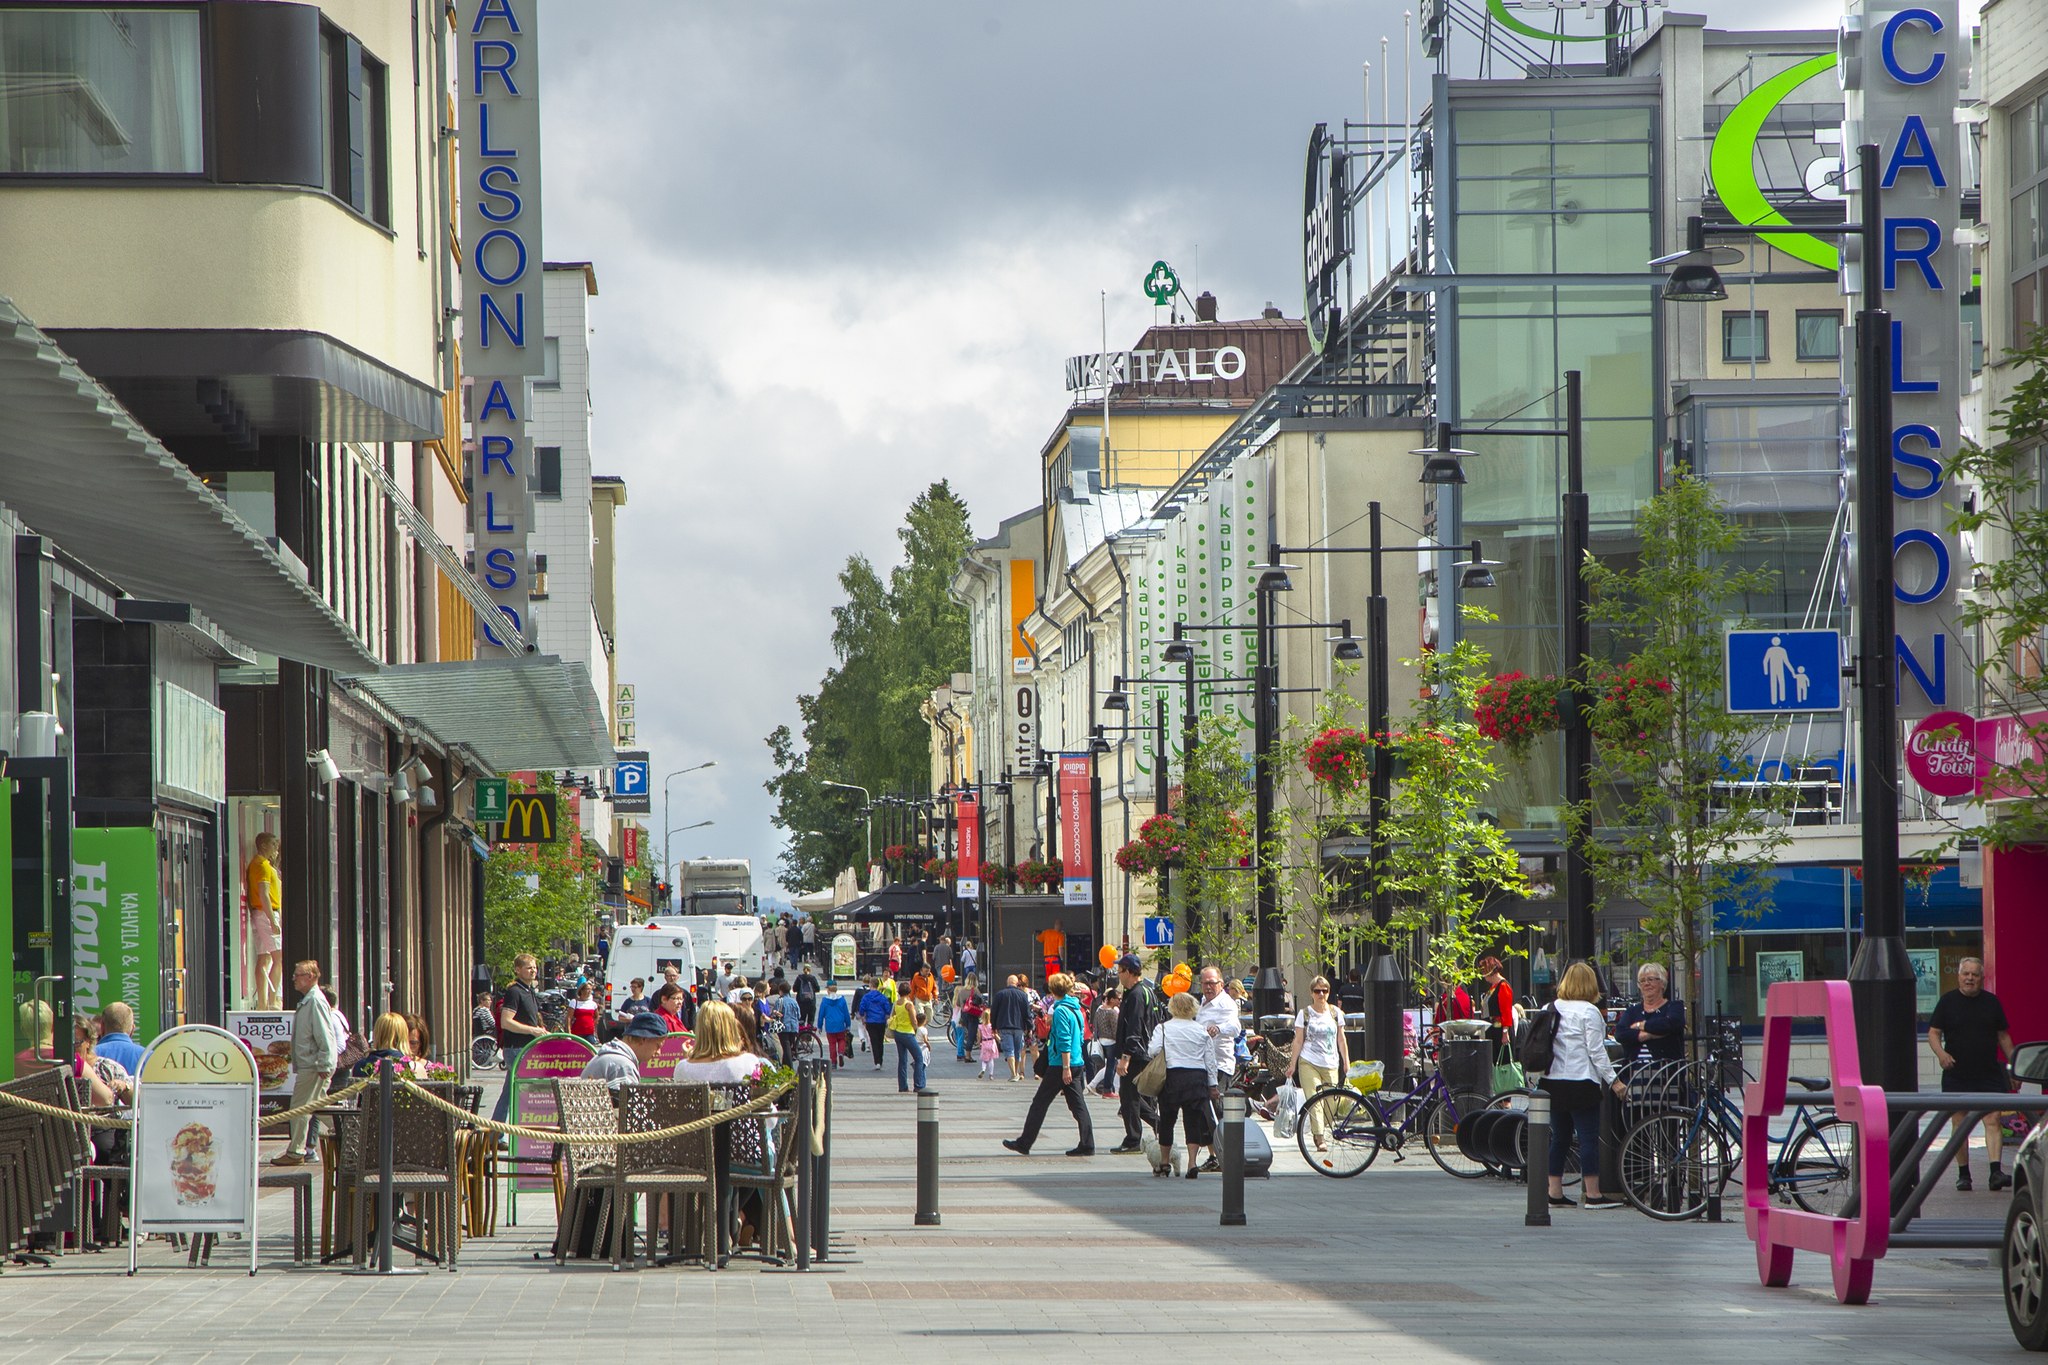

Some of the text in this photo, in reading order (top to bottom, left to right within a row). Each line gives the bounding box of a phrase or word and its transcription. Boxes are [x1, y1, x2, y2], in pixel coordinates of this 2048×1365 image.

[1880, 8, 1949, 706] CARLSON
[1072, 789, 1080, 819] KUOPIO
[120, 893, 140, 950] KAHVILA
[121, 954, 140, 967] &
[163, 1045, 233, 1076] AINO
